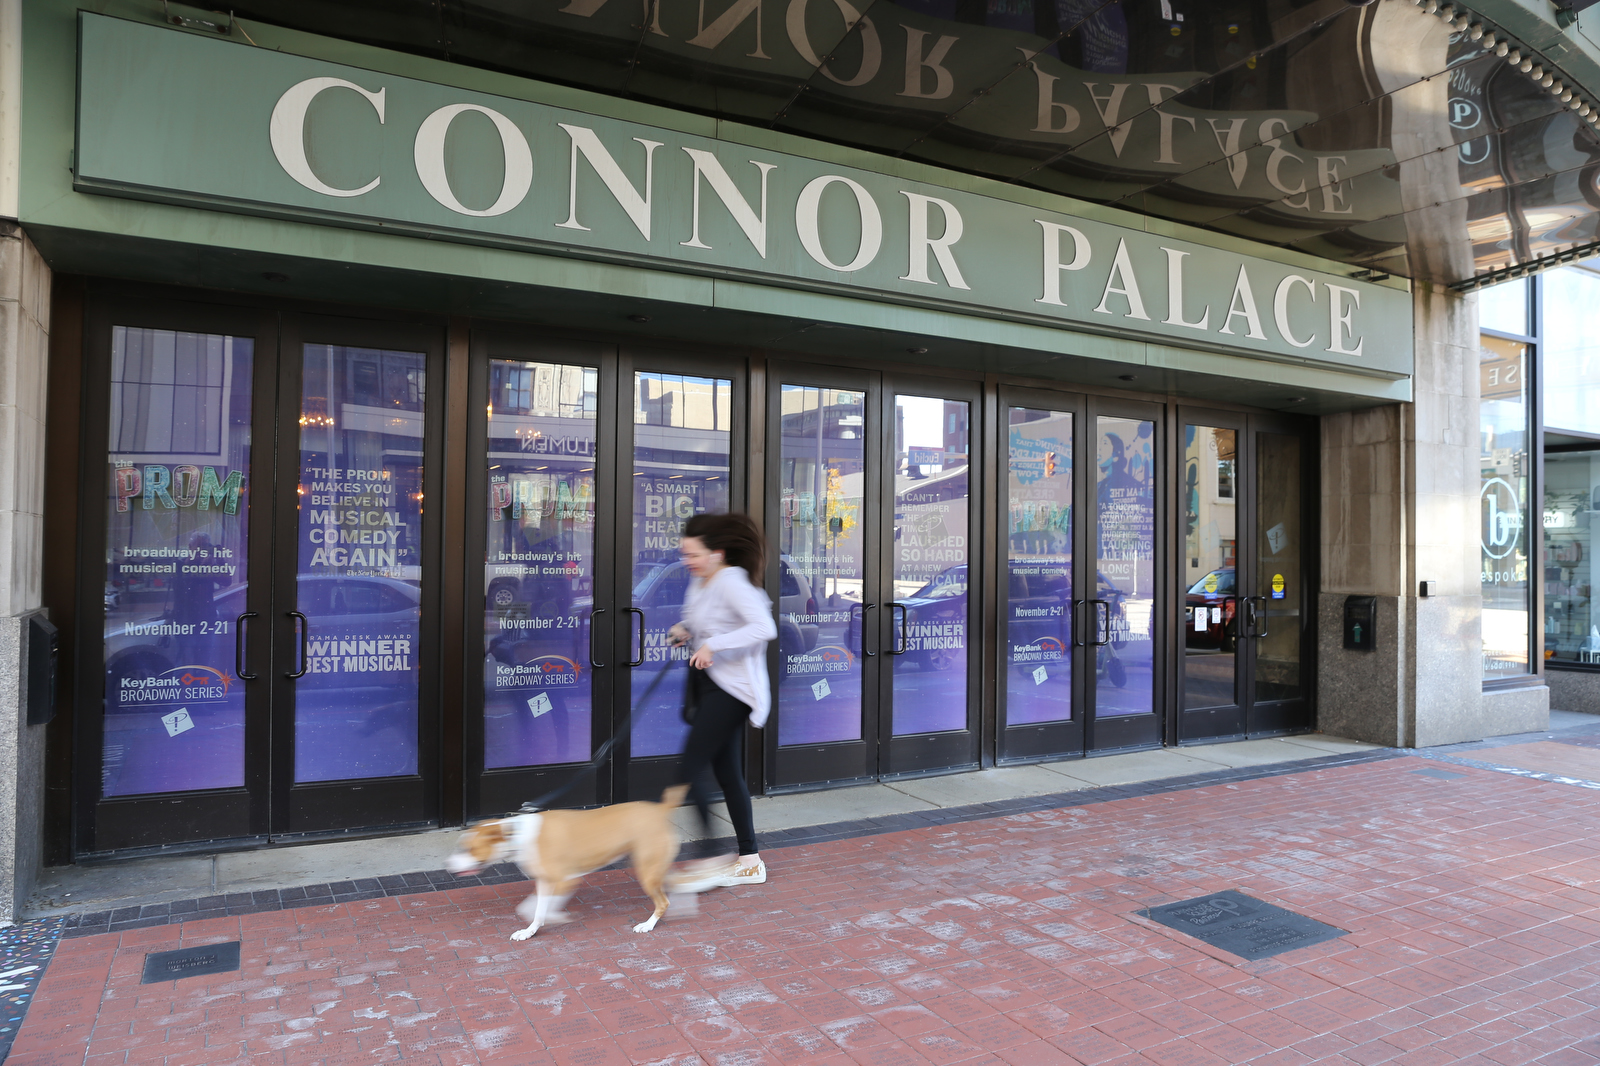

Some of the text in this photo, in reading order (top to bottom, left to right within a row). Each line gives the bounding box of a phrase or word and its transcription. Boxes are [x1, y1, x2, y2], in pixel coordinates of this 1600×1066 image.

[269, 75, 1364, 357] CONNOR PALACE
[115, 460, 133, 468] the
[347, 469, 391, 481] PROM
[115, 465, 242, 515] PROM
[312, 481, 392, 494] MAKES YOU
[656, 484, 699, 494] SMART
[312, 495, 389, 507] BELIEVE IN
[491, 480, 591, 523] PROM
[310, 510, 407, 526] MUSICAL
[309, 528, 401, 545] COMEDY
[900, 535, 965, 548] LAUGHED
[1101, 540, 1151, 550] LAUGHING
[124, 546, 233, 561] broadway's hit
[498, 551, 582, 563] broadway's hit
[788, 554, 854, 564] broadway's hit
[901, 549, 964, 562] SO HARD
[1101, 552, 1151, 561] ALL NIGHT
[120, 562, 236, 576] musical comedy
[495, 565, 584, 576] musical comedy
[786, 567, 856, 577] musical comedy
[901, 564, 942, 572] AT A NEW
[1013, 566, 1067, 576] musical comedy
[789, 611, 851, 623] November 2-21
[1015, 606, 1064, 617] November 2-21
[125, 620, 228, 636] November 2-21
[499, 616, 579, 629] November 2-21
[306, 640, 411, 656] WINNER
[923, 636, 964, 650] MUSICAL
[1014, 644, 1041, 653] KeyBank
[788, 654, 822, 663] KeyBank
[1014, 651, 1061, 661] BROADWAY SERIES
[344, 655, 411, 672] MUSICAL
[787, 662, 848, 674] BROADWAY SERIES
[496, 665, 541, 675] KeyBank
[121, 676, 180, 689] KeyBank
[496, 673, 574, 687] BROADWAY SERIES
[120, 686, 223, 702] BROADWAY SERIES
